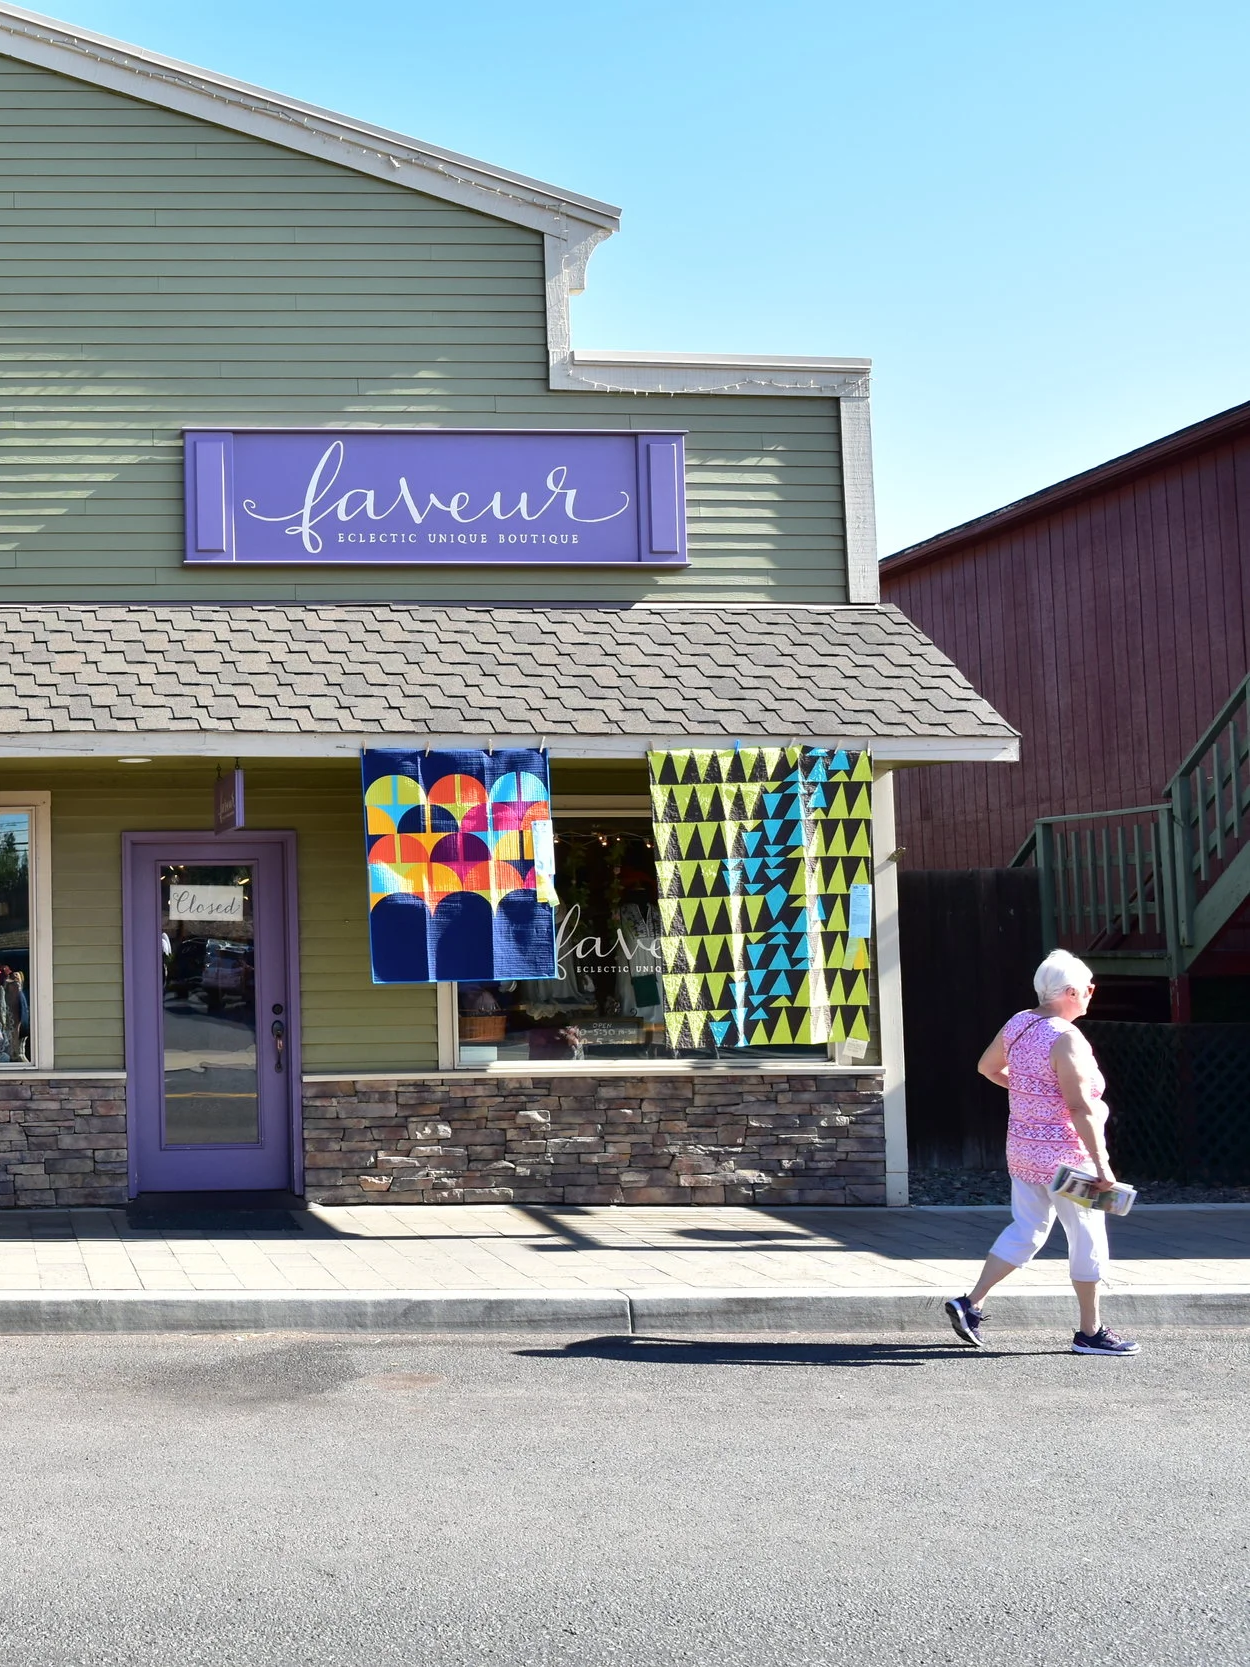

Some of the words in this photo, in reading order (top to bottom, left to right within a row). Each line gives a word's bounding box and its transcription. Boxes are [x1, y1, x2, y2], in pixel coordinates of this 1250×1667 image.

[243, 440, 629, 554] faveur
[337, 533, 418, 544] ECLECTIC
[427, 533, 488, 546] UNIQUE
[498, 534, 580, 546] BOUTIQUE
[172, 890, 241, 915] Closed
[576, 965, 630, 974] ECLECTIC
